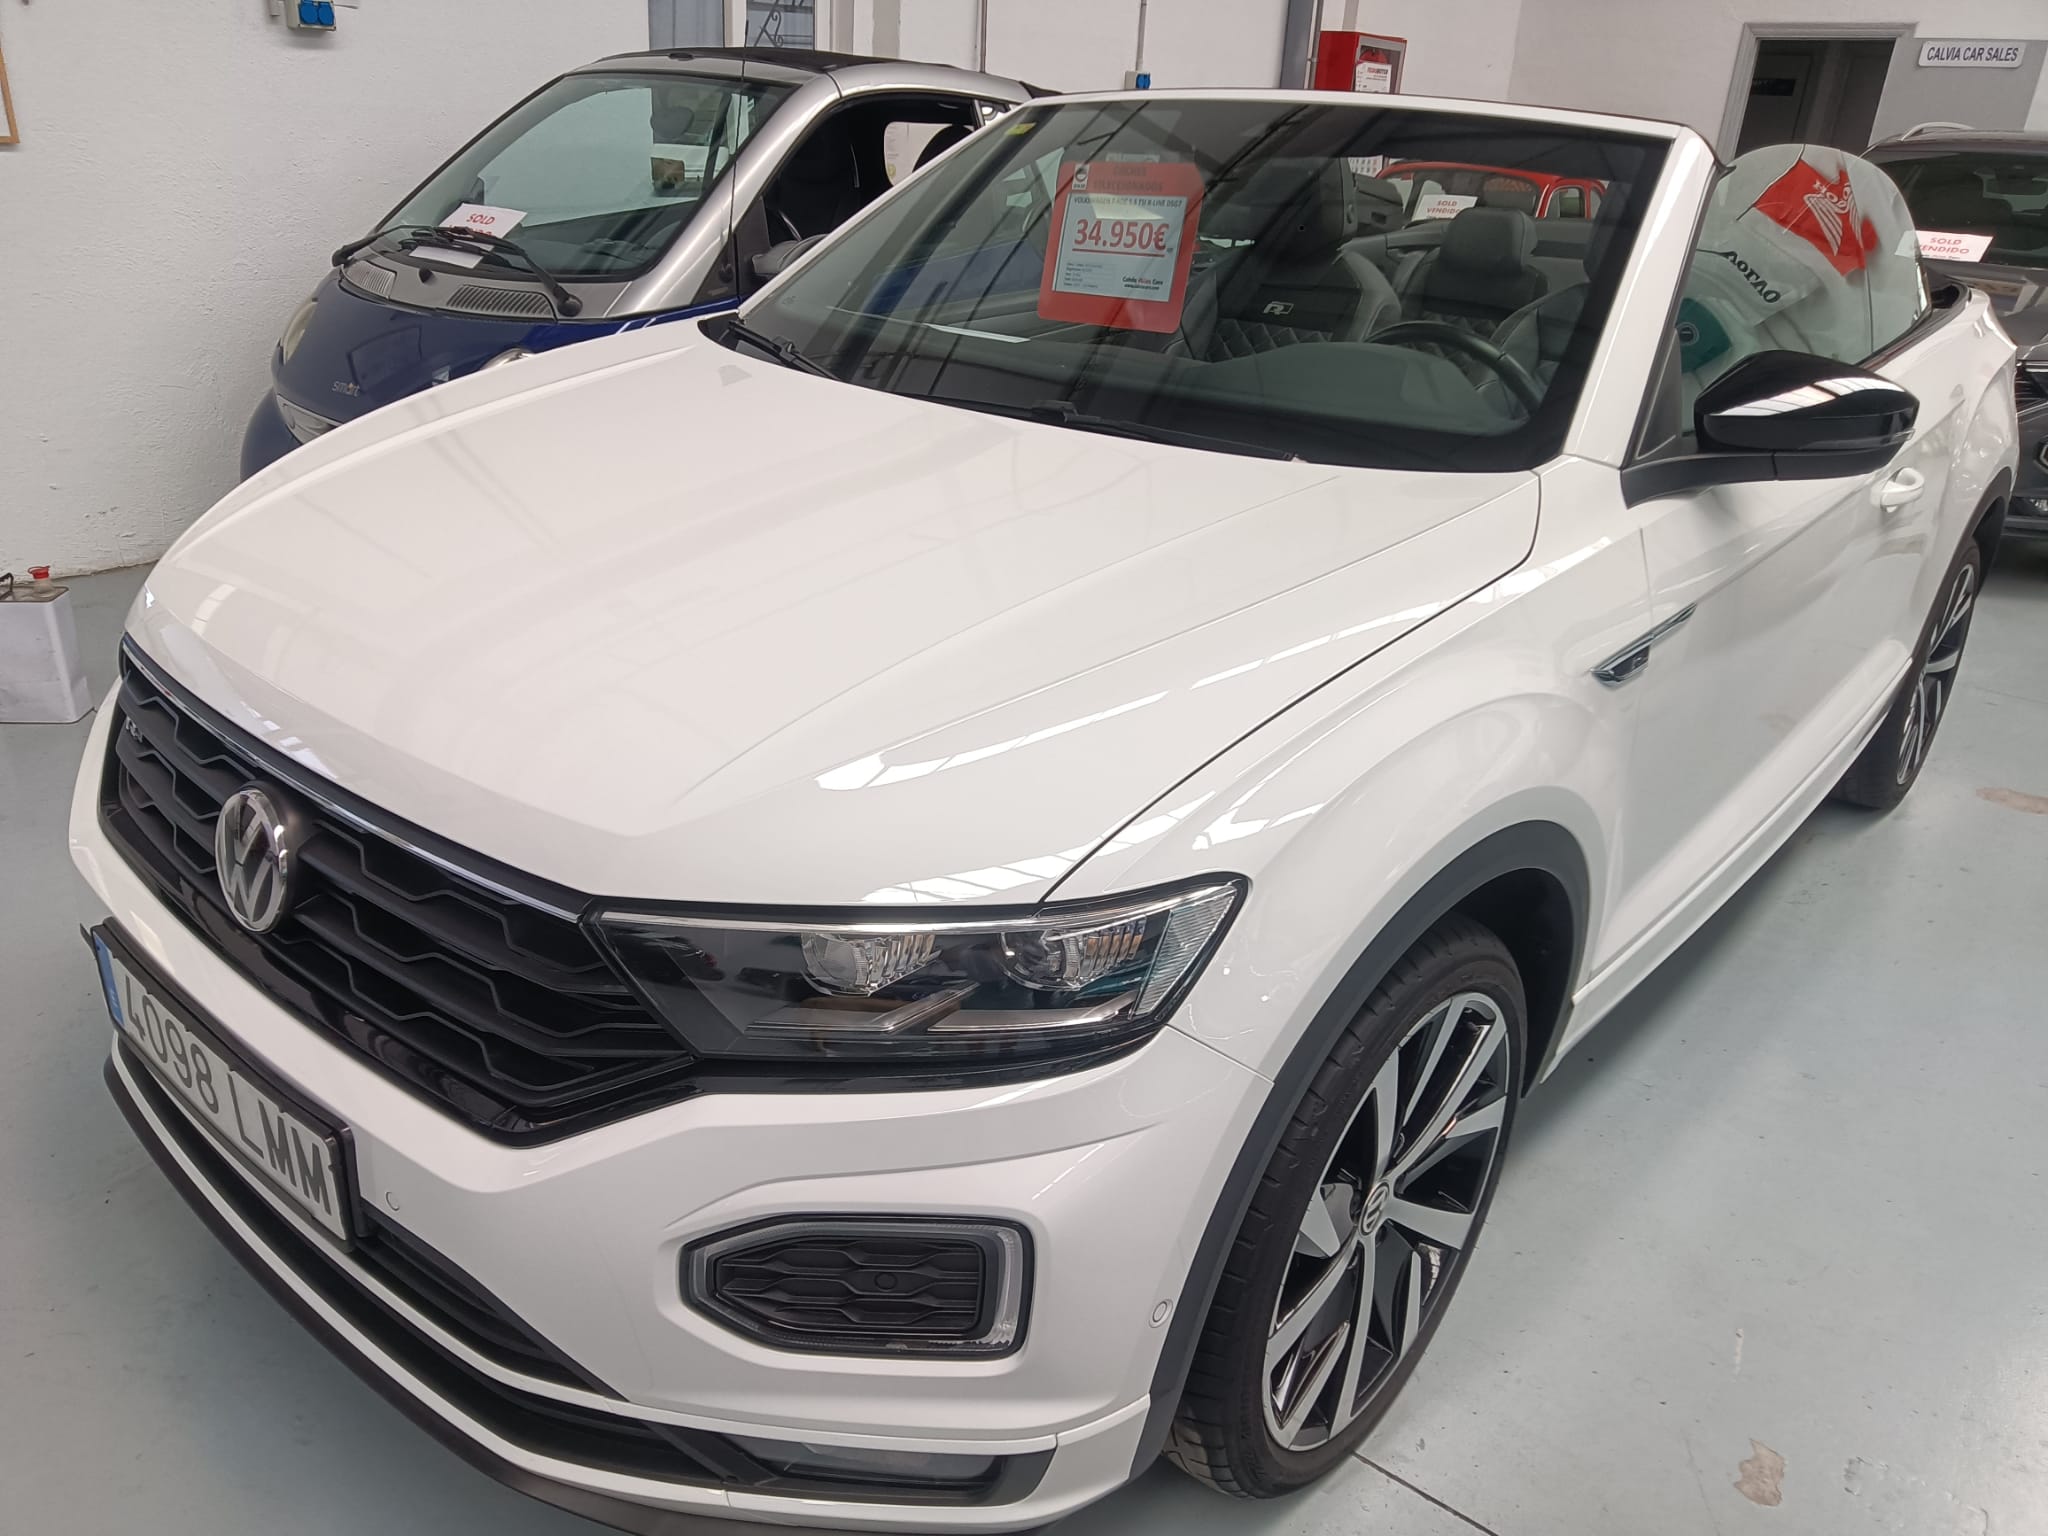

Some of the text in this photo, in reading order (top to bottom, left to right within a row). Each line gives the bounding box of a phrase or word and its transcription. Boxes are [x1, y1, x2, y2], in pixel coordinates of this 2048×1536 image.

[1927, 46, 2019, 62] CALVIA CAR SALES
[466, 213, 495, 225] SOLD
[1074, 219, 1169, 251] 34.950€
[1930, 237, 1962, 246] SOLD
[1919, 245, 1970, 254] ENDIDO
[331, 381, 360, 397] smart
[125, 974, 332, 1217] 4098 LMM
